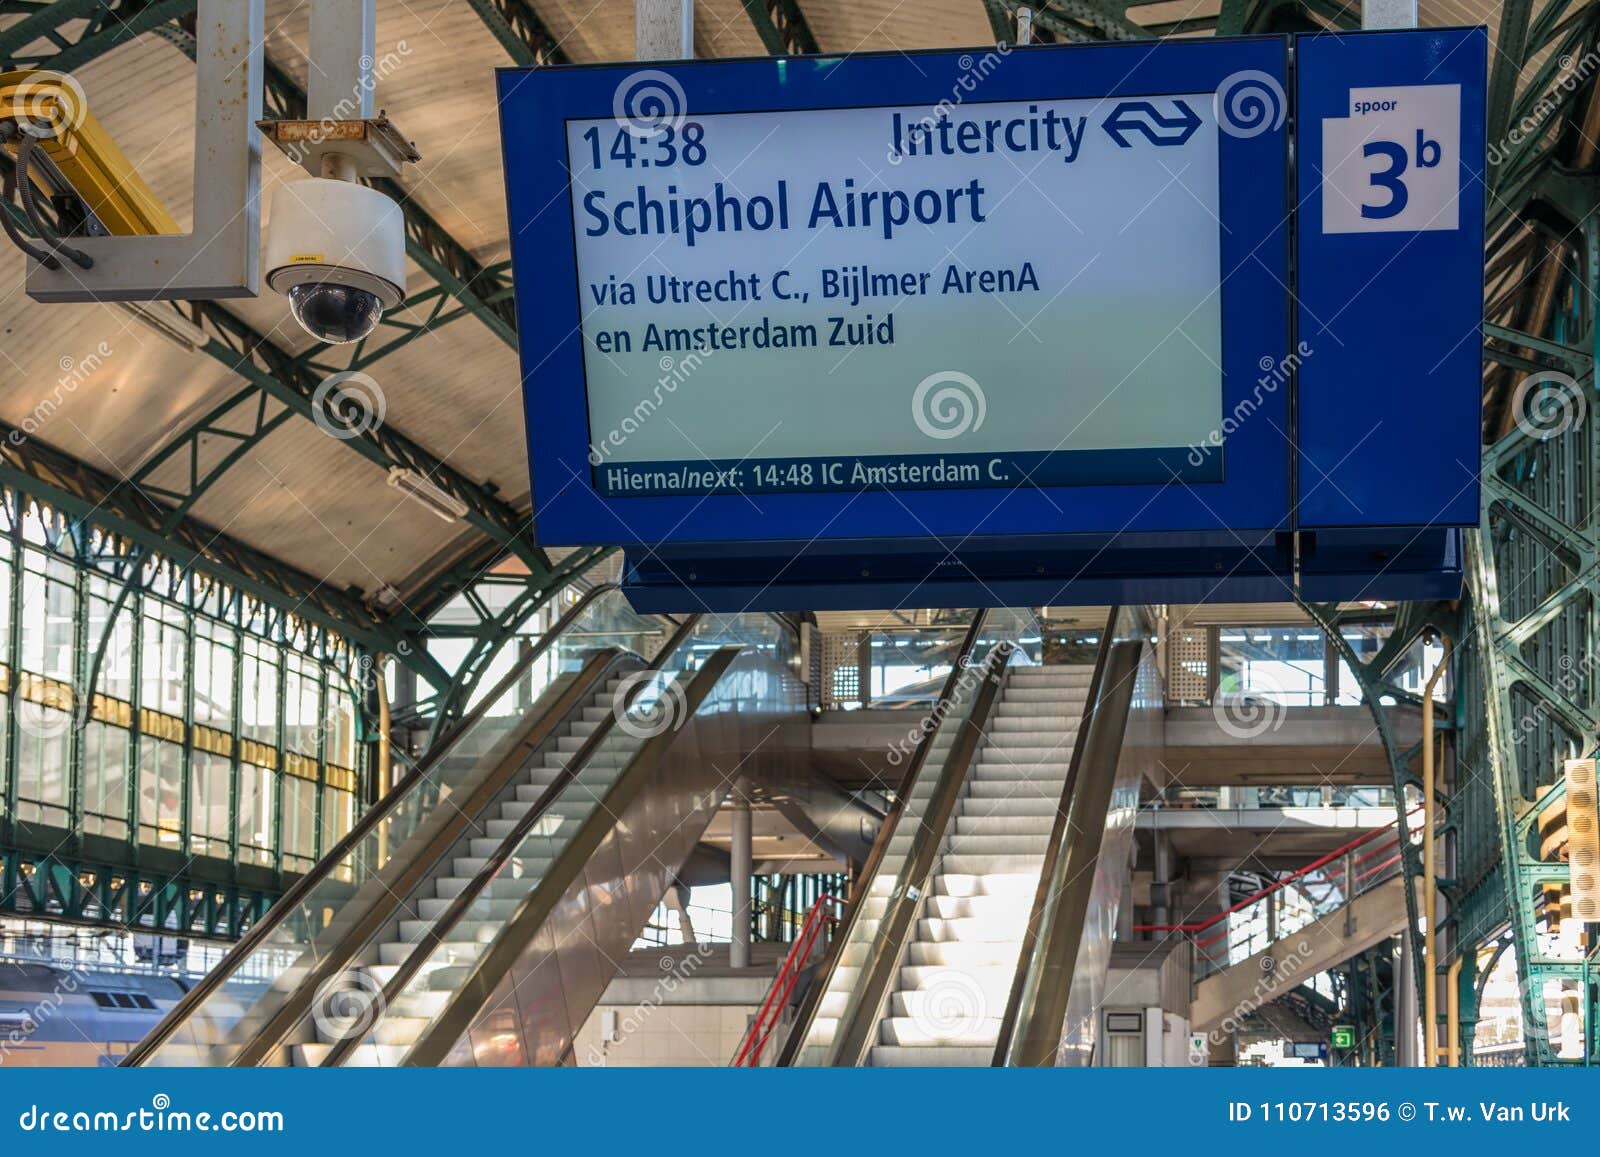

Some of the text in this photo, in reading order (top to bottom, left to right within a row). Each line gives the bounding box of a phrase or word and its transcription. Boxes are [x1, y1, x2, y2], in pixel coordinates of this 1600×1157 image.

[1354, 100, 1398, 115] spoor
[584, 121, 708, 171] 14:38
[892, 104, 1088, 163] Intercity
[584, 178, 987, 247] Schiphol Airport
[591, 262, 1040, 307] via Utrecht C., Bijlmer ArenA
[596, 313, 895, 353] en Amsterdam Zuid
[606, 459, 1009, 492] Hierna/next: 14:48 IC Amsterdam C.
